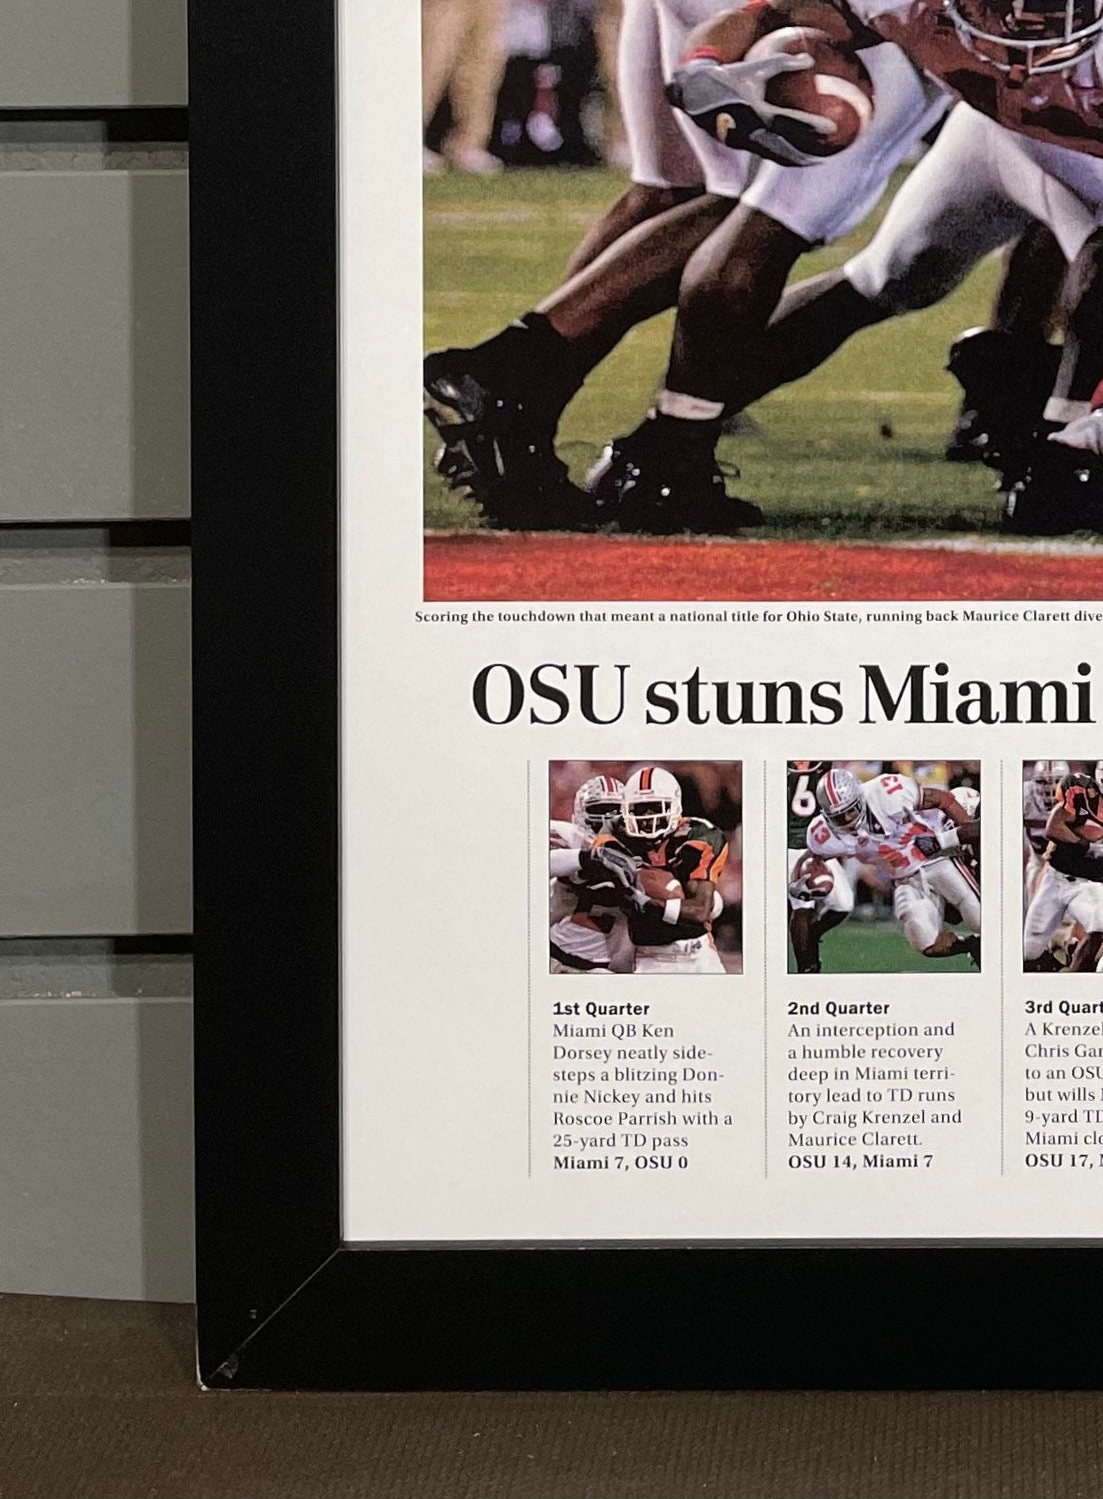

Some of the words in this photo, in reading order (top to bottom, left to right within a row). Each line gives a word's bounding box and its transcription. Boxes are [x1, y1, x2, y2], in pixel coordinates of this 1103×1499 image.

[415, 611, 469, 626] Scoring
[472, 610, 495, 622] the
[498, 610, 575, 622] touchdown
[579, 610, 607, 622] that
[610, 612, 655, 622] meant
[658, 613, 666, 622] a
[670, 610, 728, 622] national
[731, 610, 759, 623] title
[762, 610, 783, 623] for
[786, 610, 820, 622] Ohio
[823, 610, 862, 624] State,
[866, 610, 923, 625] running
[926, 609, 959, 622] back
[962, 610, 1019, 622] Maurice
[1022, 609, 1070, 622] Clarett
[472, 663, 631, 725] OSU
[645, 666, 844, 726] stuns
[858, 661, 1097, 725] Miami
[552, 1001, 581, 1016] 1st
[585, 1001, 650, 1018] Quarter
[787, 1001, 820, 1016] 2nd
[825, 1001, 890, 1018] Quarter
[1024, 1000, 1053, 1014] 3rd
[787, 1023, 811, 1038] An
[816, 1023, 919, 1041] interception
[923, 1021, 955, 1037] and
[1024, 1022, 1037, 1036] A
[553, 1045, 612, 1064] Dorsey
[617, 1044, 668, 1064] neatly
[672, 1044, 713, 1060] side-
[787, 1049, 797, 1060] a
[802, 1043, 866, 1060] humble
[871, 1047, 943, 1063] recovery
[1024, 1043, 1070, 1058] Chris
[553, 1069, 596, 1086] steps
[600, 1071, 610, 1082] a
[614, 1066, 678, 1086] blitzing
[682, 1067, 724, 1082] Don-
[1025, 1086, 1052, 1102] but
[1057, 1086, 1096, 1102] wills
[553, 1111, 613, 1126] Roscoe
[618, 1110, 677, 1126] Parrish
[682, 1110, 719, 1126] with
[723, 1115, 733, 1126] a
[788, 1110, 808, 1130] by
[812, 1110, 858, 1129] Craig
[862, 1109, 926, 1124] Krenzel
[930, 1109, 962, 1124] and
[554, 1155, 609, 1170] Miami
[614, 1156, 629, 1172] 7,
[634, 1155, 673, 1170] OSU
[678, 1155, 688, 1169] 0
[788, 1154, 826, 1169] OSU
[833, 1155, 857, 1171] 14,
[863, 1154, 918, 1168] Miami
[923, 1154, 933, 1168] 7
[1025, 1153, 1063, 1168] OSU
[1070, 1154, 1094, 1170] 17,
